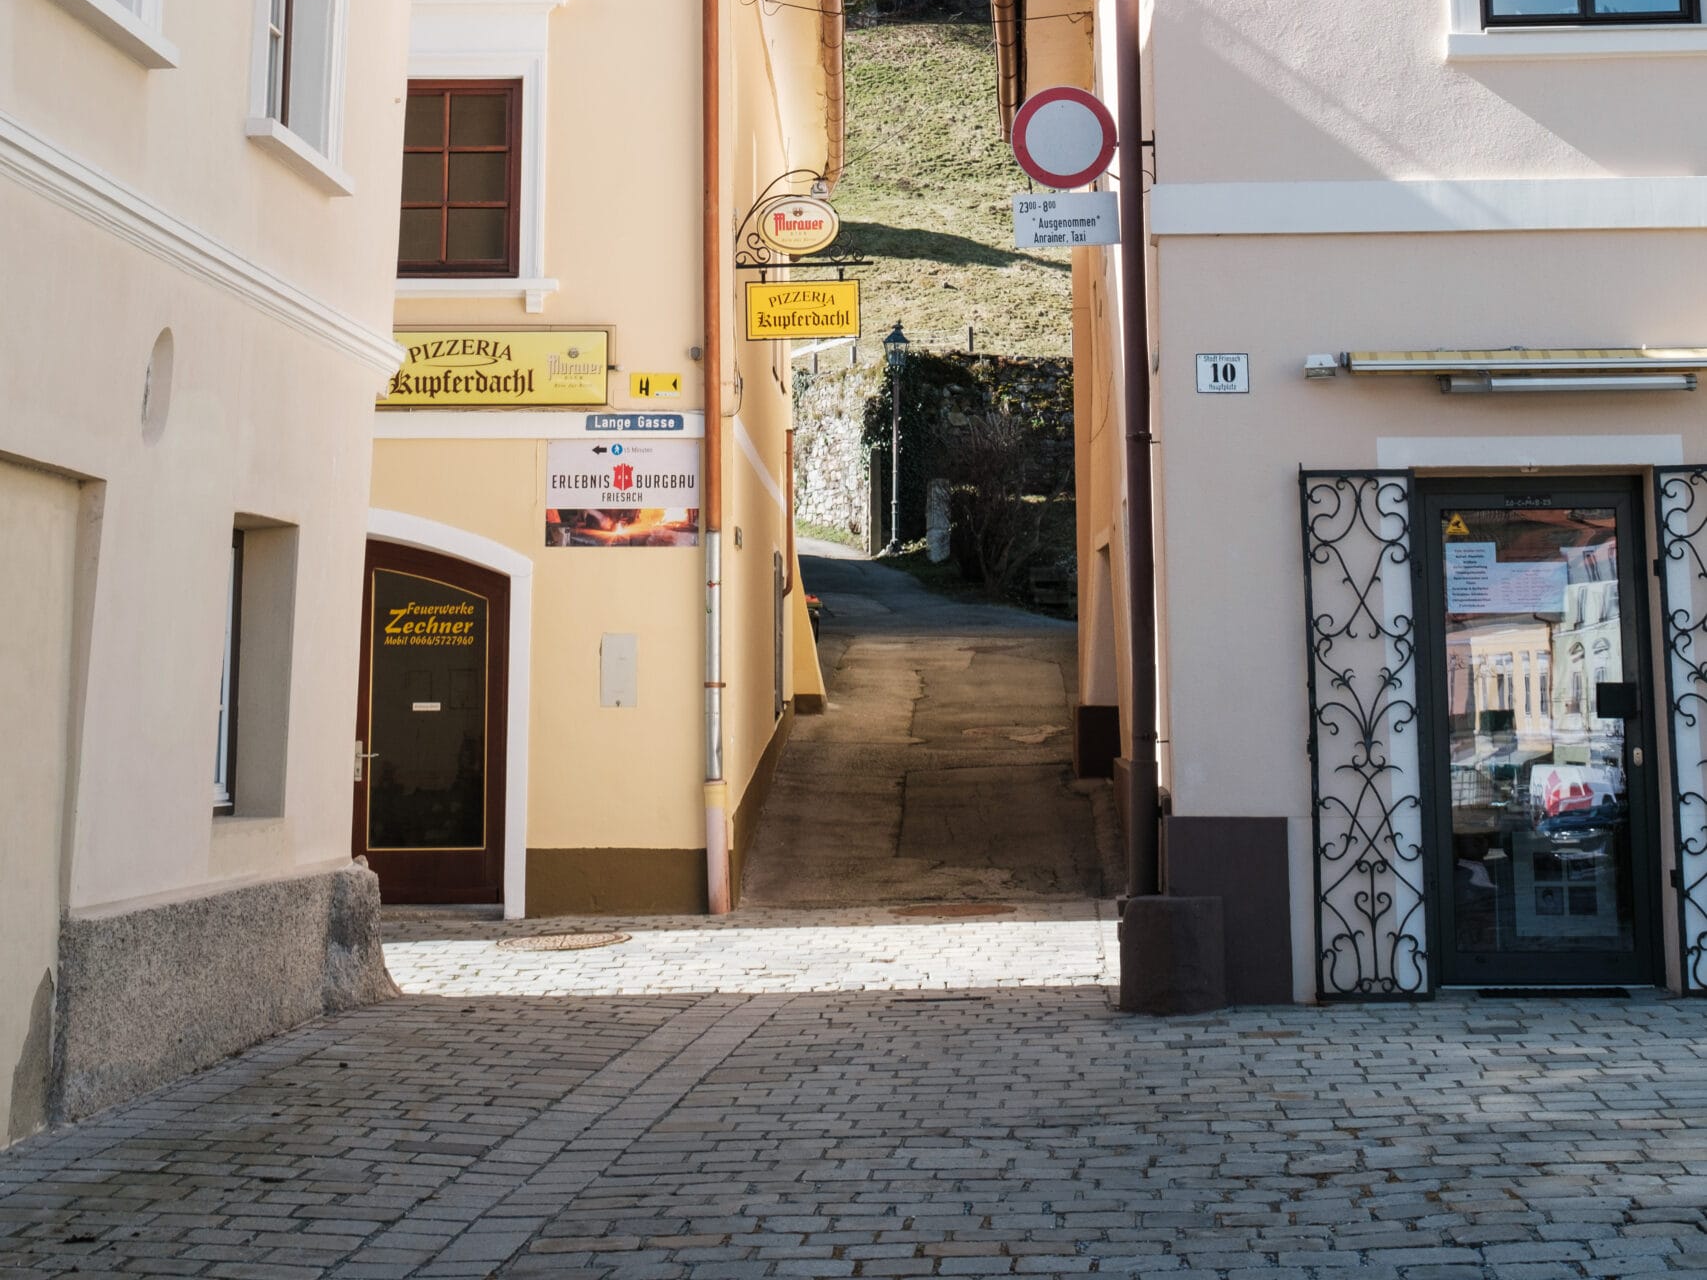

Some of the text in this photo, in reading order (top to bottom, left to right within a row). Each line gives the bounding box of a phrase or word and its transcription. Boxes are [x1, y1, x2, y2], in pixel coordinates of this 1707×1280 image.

[774, 213, 824, 236] Murauer
[1071, 231, 1087, 242] Taxi
[768, 291, 836, 308] PIZZERIA
[757, 310, 850, 330] Kupferdachl
[408, 339, 513, 364] PIZZERIA
[1211, 363, 1236, 383] 10
[389, 368, 536, 399] Kupferdachl
[594, 415, 675, 431] Lange Gasse
[552, 474, 695, 489] ERLEBNIS BURGBAU
[601, 492, 643, 502] FRIESACH
[406, 602, 475, 615] Feuerwerke
[384, 609, 474, 634] Zechner
[384, 635, 408, 646] Mobil
